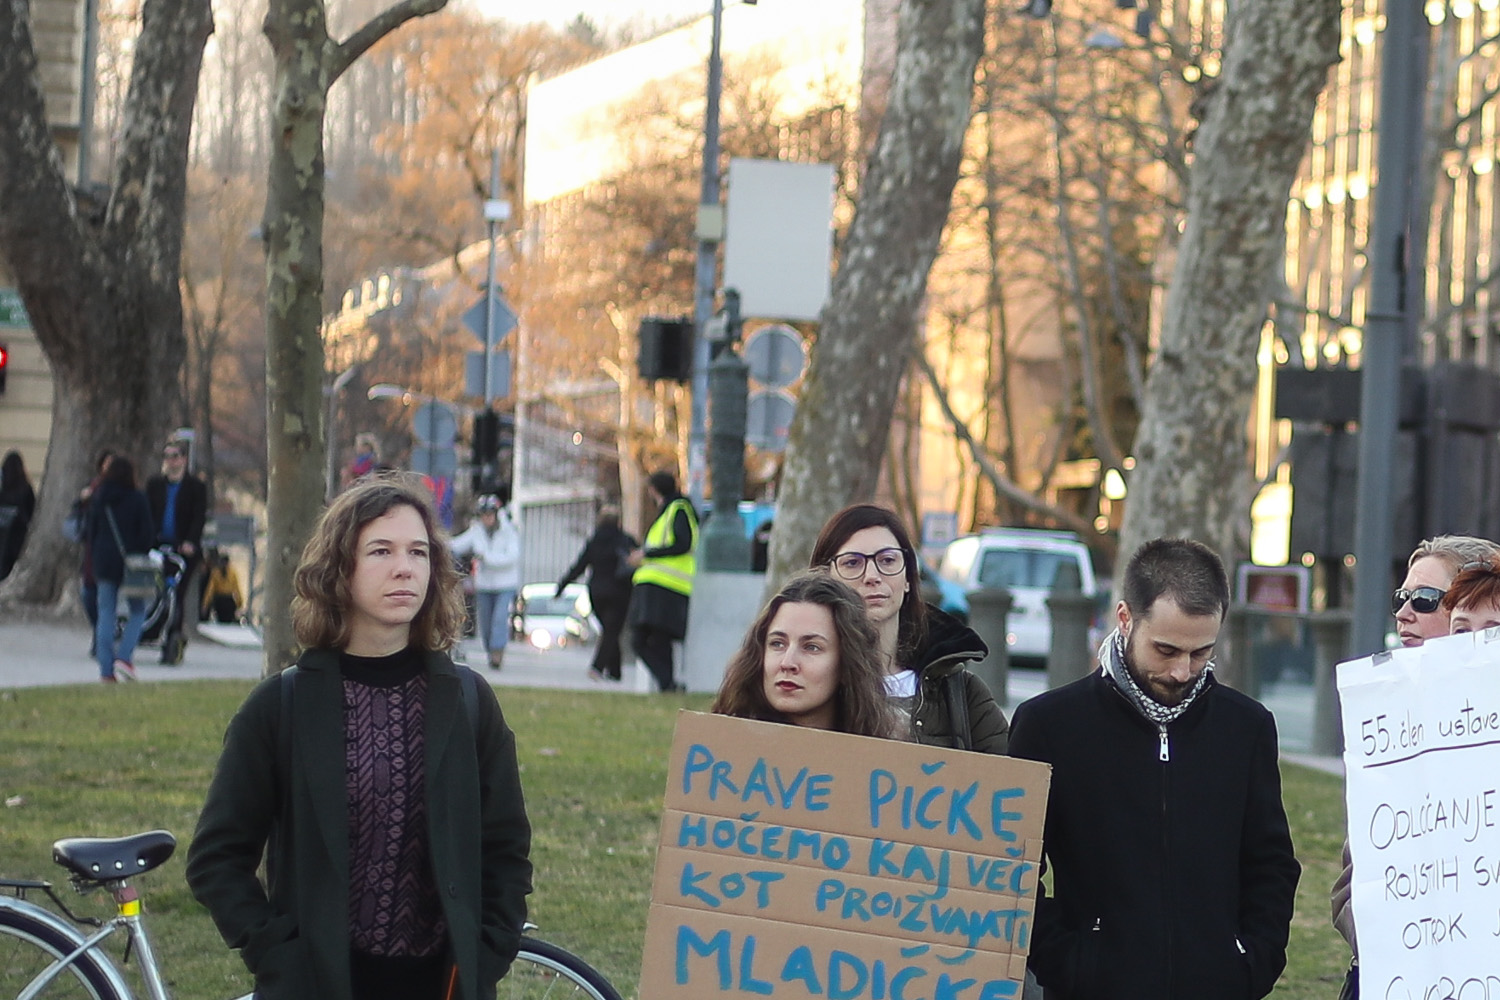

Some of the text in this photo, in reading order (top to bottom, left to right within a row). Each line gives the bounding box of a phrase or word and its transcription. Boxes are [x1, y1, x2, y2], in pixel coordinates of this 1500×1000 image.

[682, 743, 1027, 842] PRAVE PIČKE
[677, 810, 1033, 900] HOČEMO KAJ VEČ
[679, 861, 786, 909] KOT
